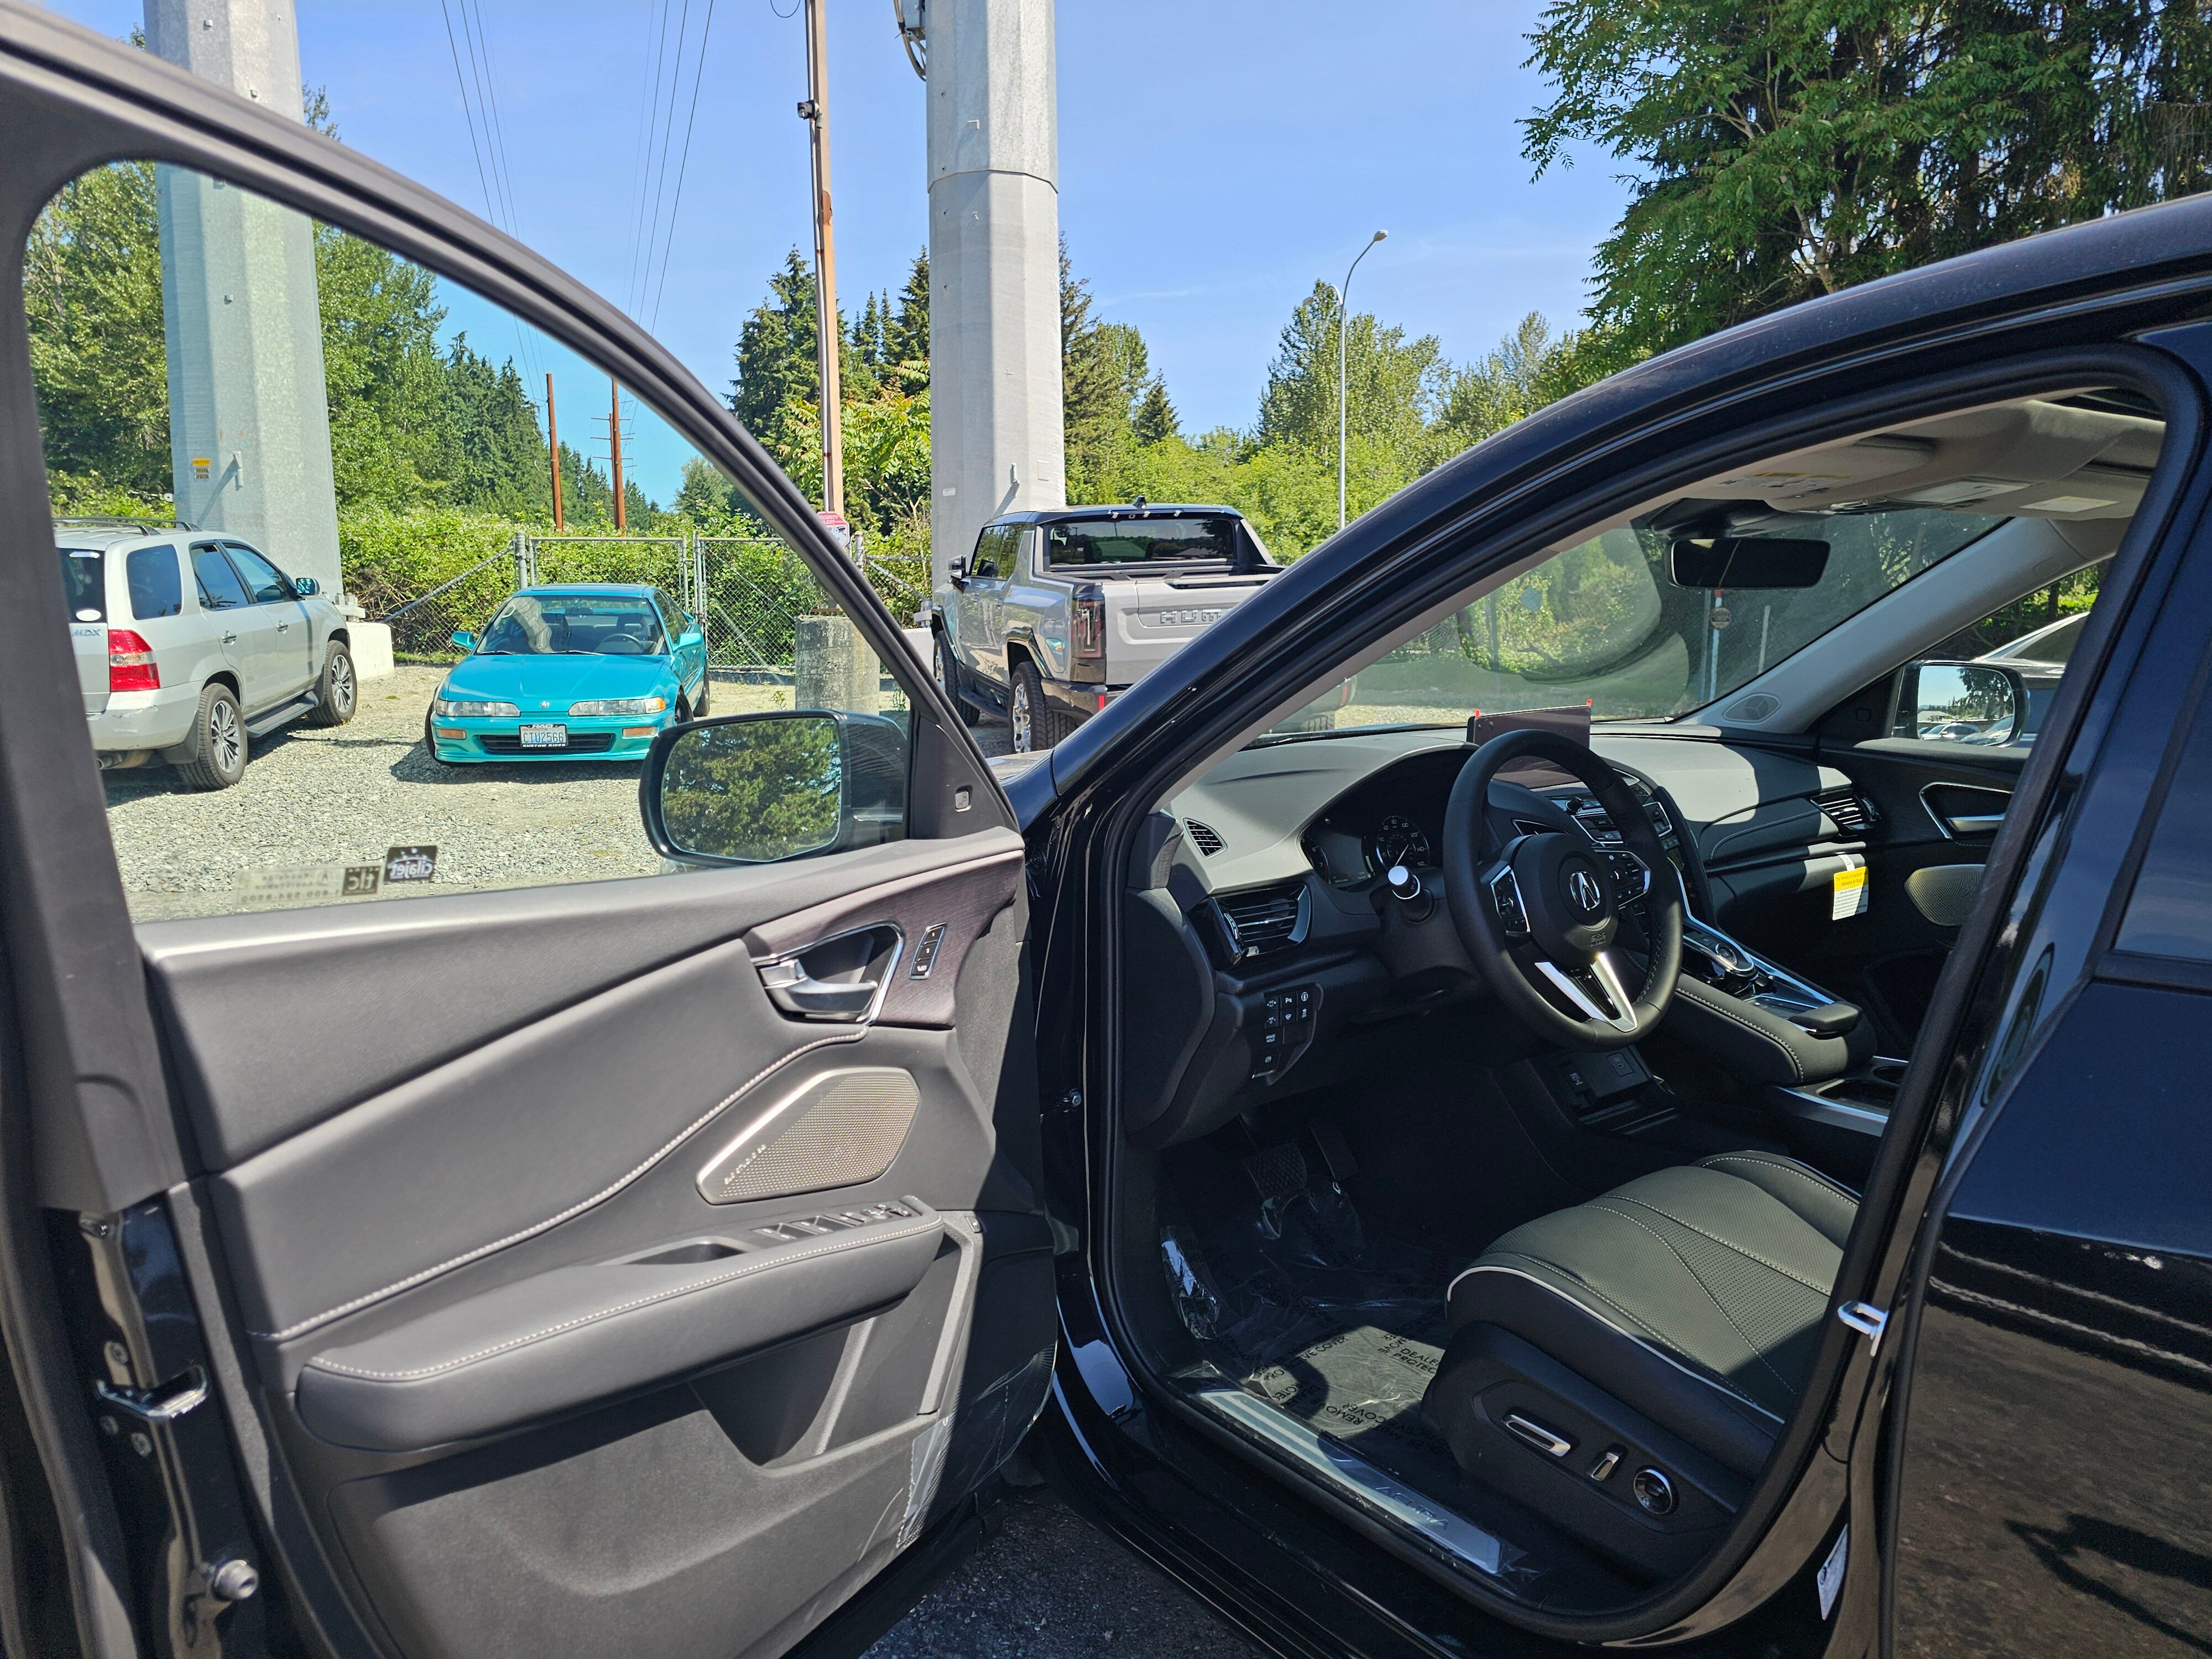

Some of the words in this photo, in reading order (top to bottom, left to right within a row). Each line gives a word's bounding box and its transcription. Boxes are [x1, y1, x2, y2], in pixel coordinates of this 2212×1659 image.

[523, 732, 564, 743] CTU2566
[1316, 1335, 1349, 1352] COVER
[1343, 1402, 1386, 1423] COVER
[1375, 1486, 1448, 1531] ACURA
